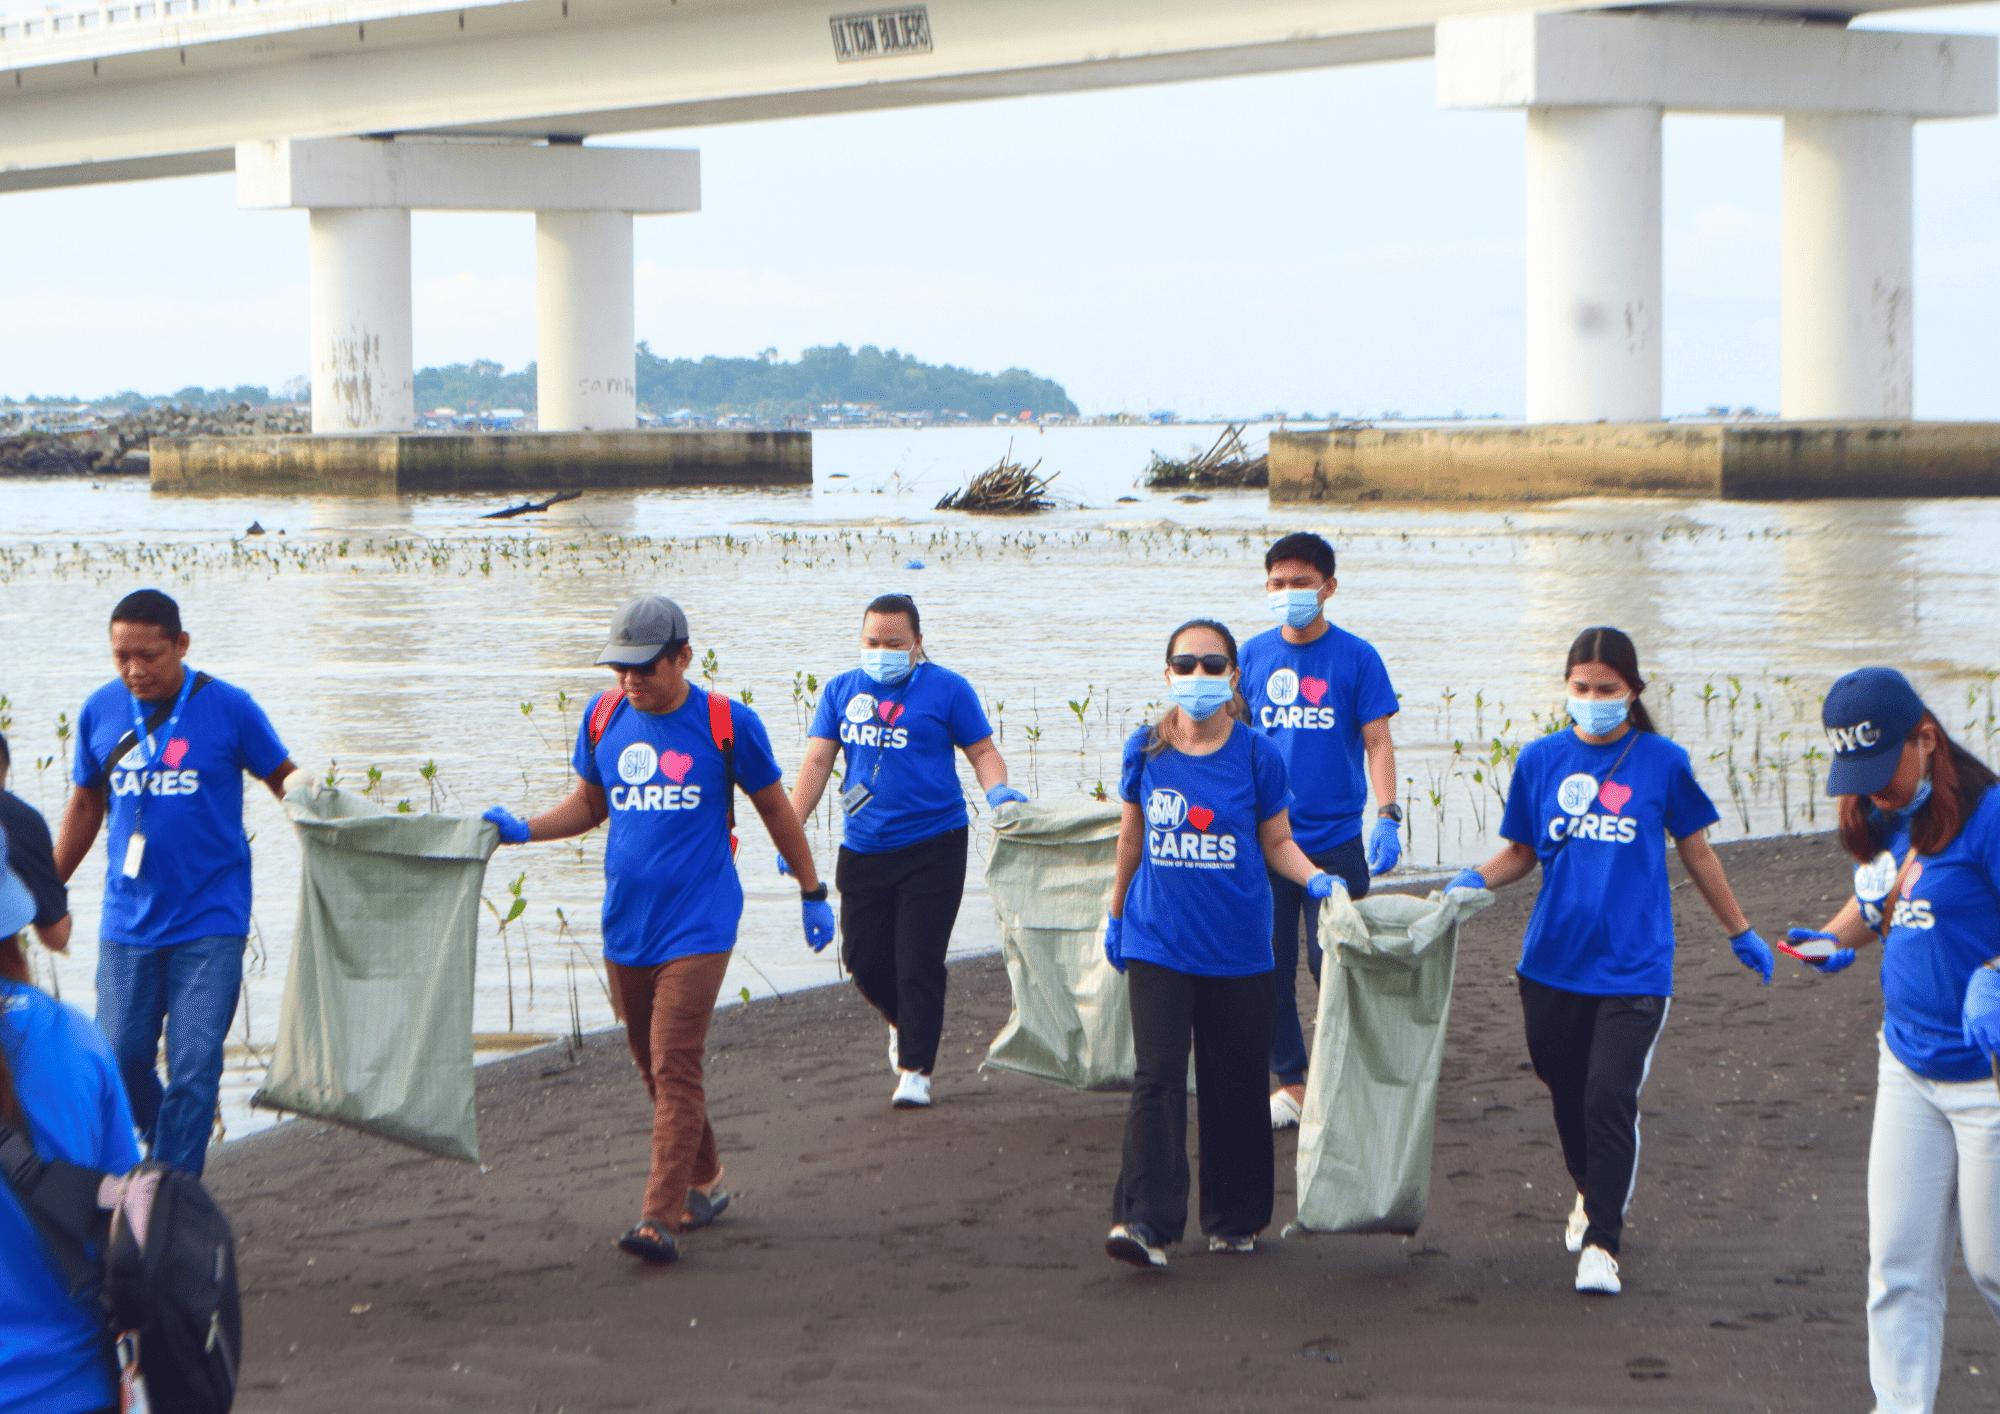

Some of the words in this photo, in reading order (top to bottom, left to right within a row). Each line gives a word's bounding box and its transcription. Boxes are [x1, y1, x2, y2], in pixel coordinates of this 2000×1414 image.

[878, 13, 928, 51] BUILDERS
[1269, 673, 1296, 702] SM
[1260, 706, 1336, 730] CARES
[839, 722, 909, 750] CARES
[621, 748, 653, 780] SM
[610, 785, 702, 812] CARES
[1147, 789, 1184, 828] SM
[1149, 829, 1237, 862] CARES
[1194, 862, 1236, 870] FOUNDATION
